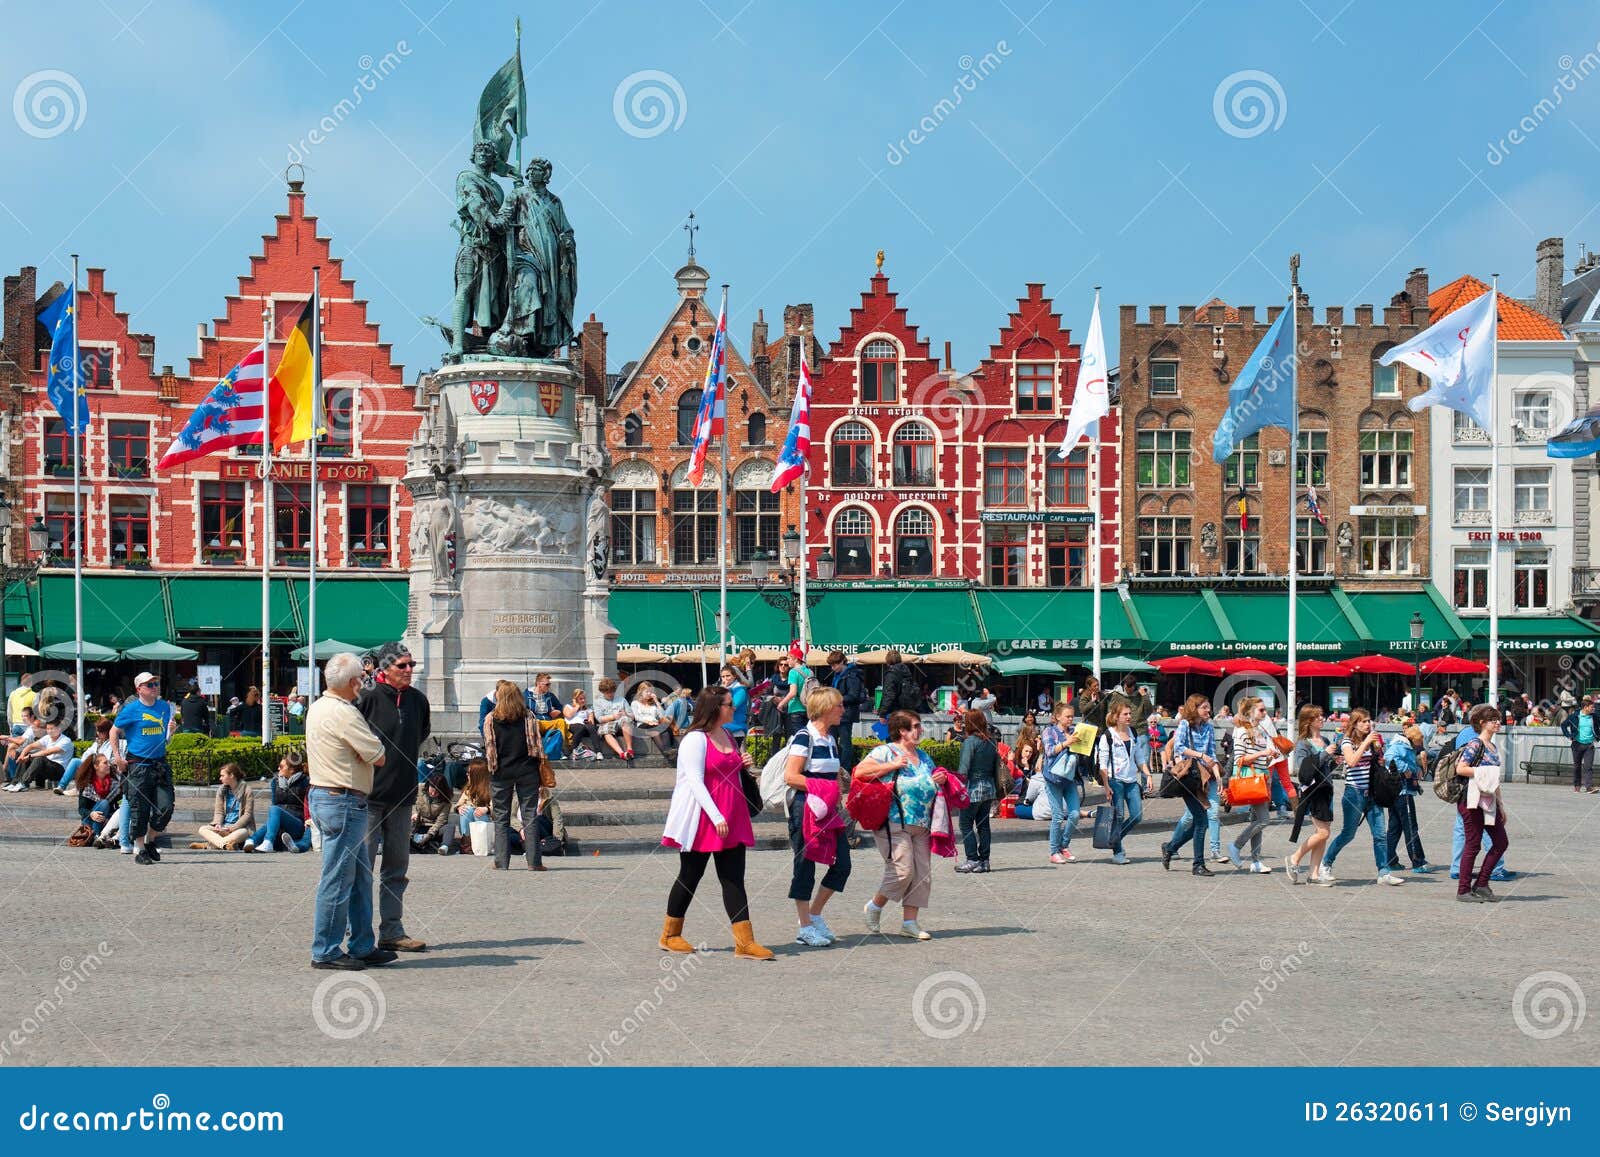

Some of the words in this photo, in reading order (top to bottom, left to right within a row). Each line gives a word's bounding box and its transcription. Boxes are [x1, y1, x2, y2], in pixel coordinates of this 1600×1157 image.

[226, 465, 249, 477] LE
[818, 492, 831, 501] de
[982, 513, 1045, 521] RESTAURANT
[1468, 532, 1515, 540] FRITRIE
[620, 573, 647, 581] HOTEL
[665, 573, 721, 581] RESTAURANT
[649, 643, 722, 654] RESTAUR
[808, 644, 858, 654] RASSERIE
[931, 642, 965, 653] HOTEL
[1011, 639, 1047, 649] CAFE
[1052, 639, 1079, 649] DES
[1085, 639, 1122, 649] ARTS
[1170, 642, 1214, 650] Brasserie
[1222, 642, 1233, 650] La
[1269, 642, 1288, 650] d'Or
[1296, 642, 1342, 650] Restaurant
[1421, 640, 1448, 649] CAFE
[1496, 640, 1550, 649] Friterie
[1555, 640, 1595, 649] 1900
